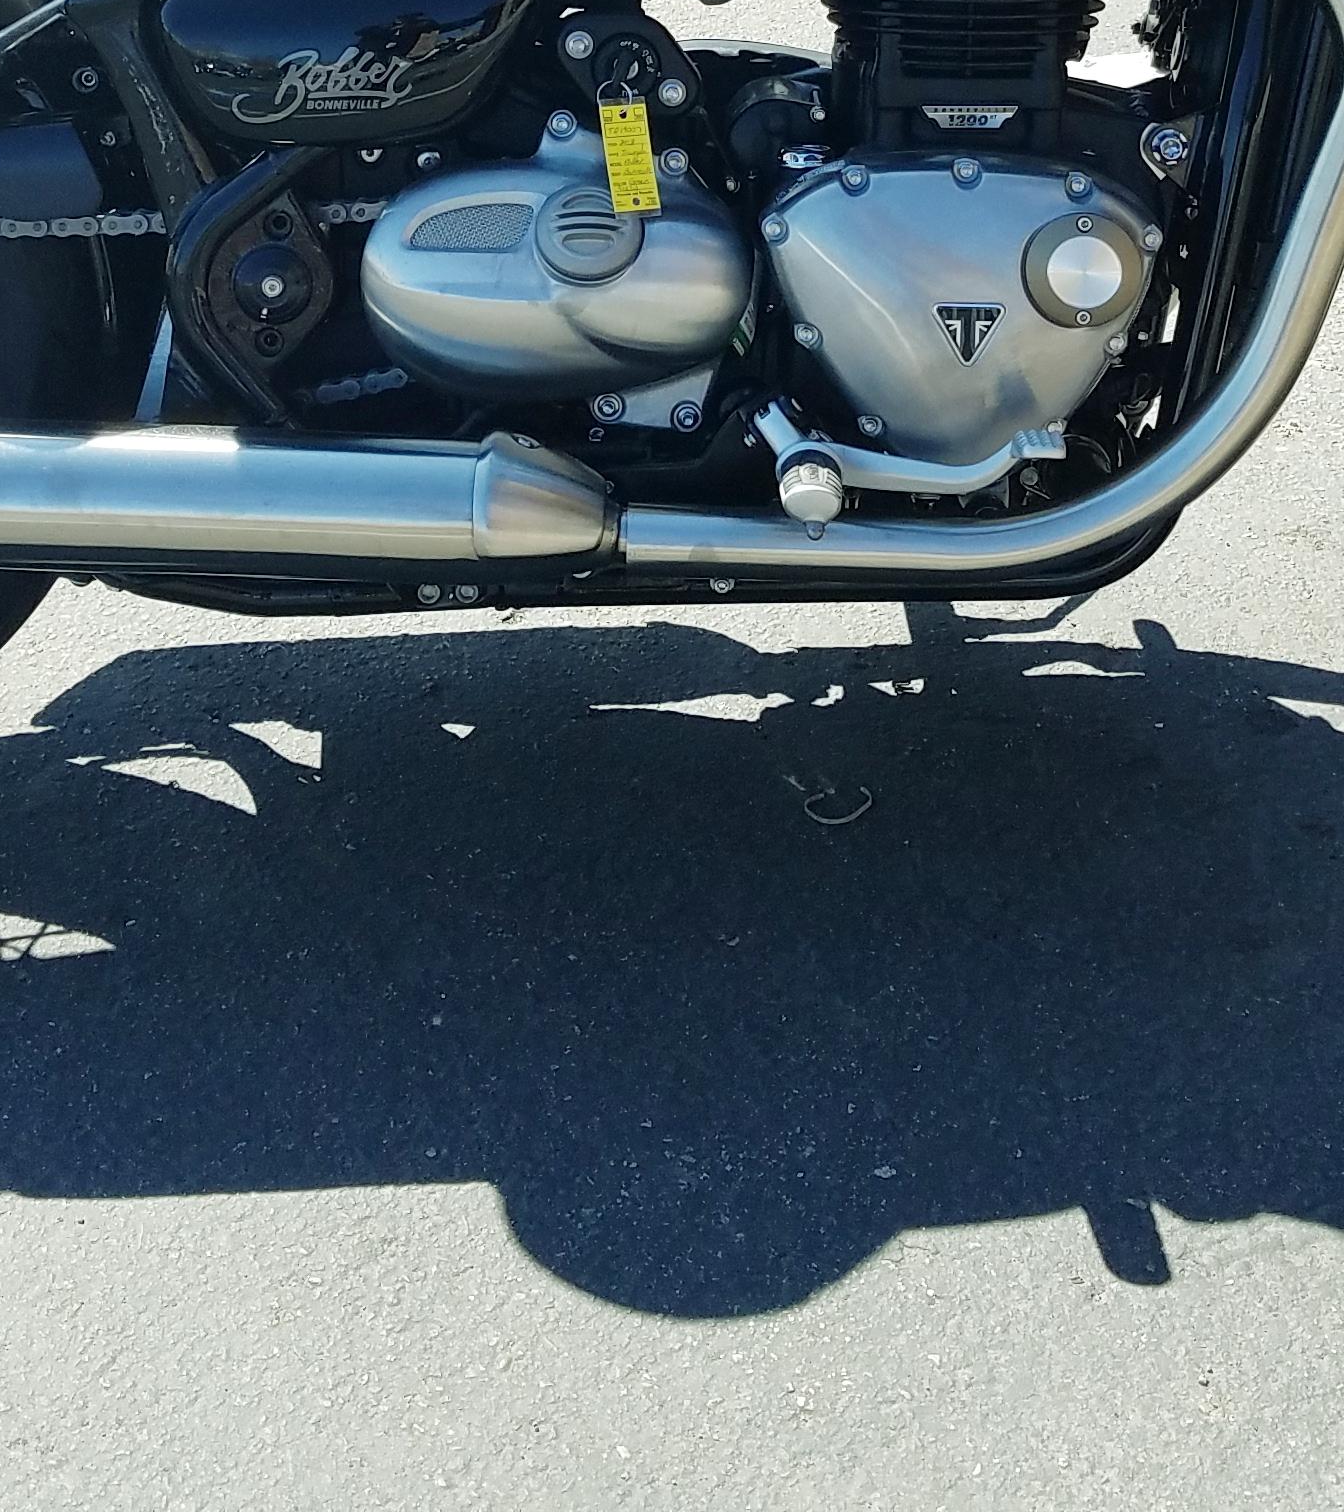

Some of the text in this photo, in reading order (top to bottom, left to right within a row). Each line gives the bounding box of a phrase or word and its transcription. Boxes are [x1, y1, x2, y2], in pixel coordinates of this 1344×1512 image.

[232, 46, 414, 124] Bobber
[306, 99, 381, 110] BONNEVILLE
[948, 114, 989, 127] 1200
